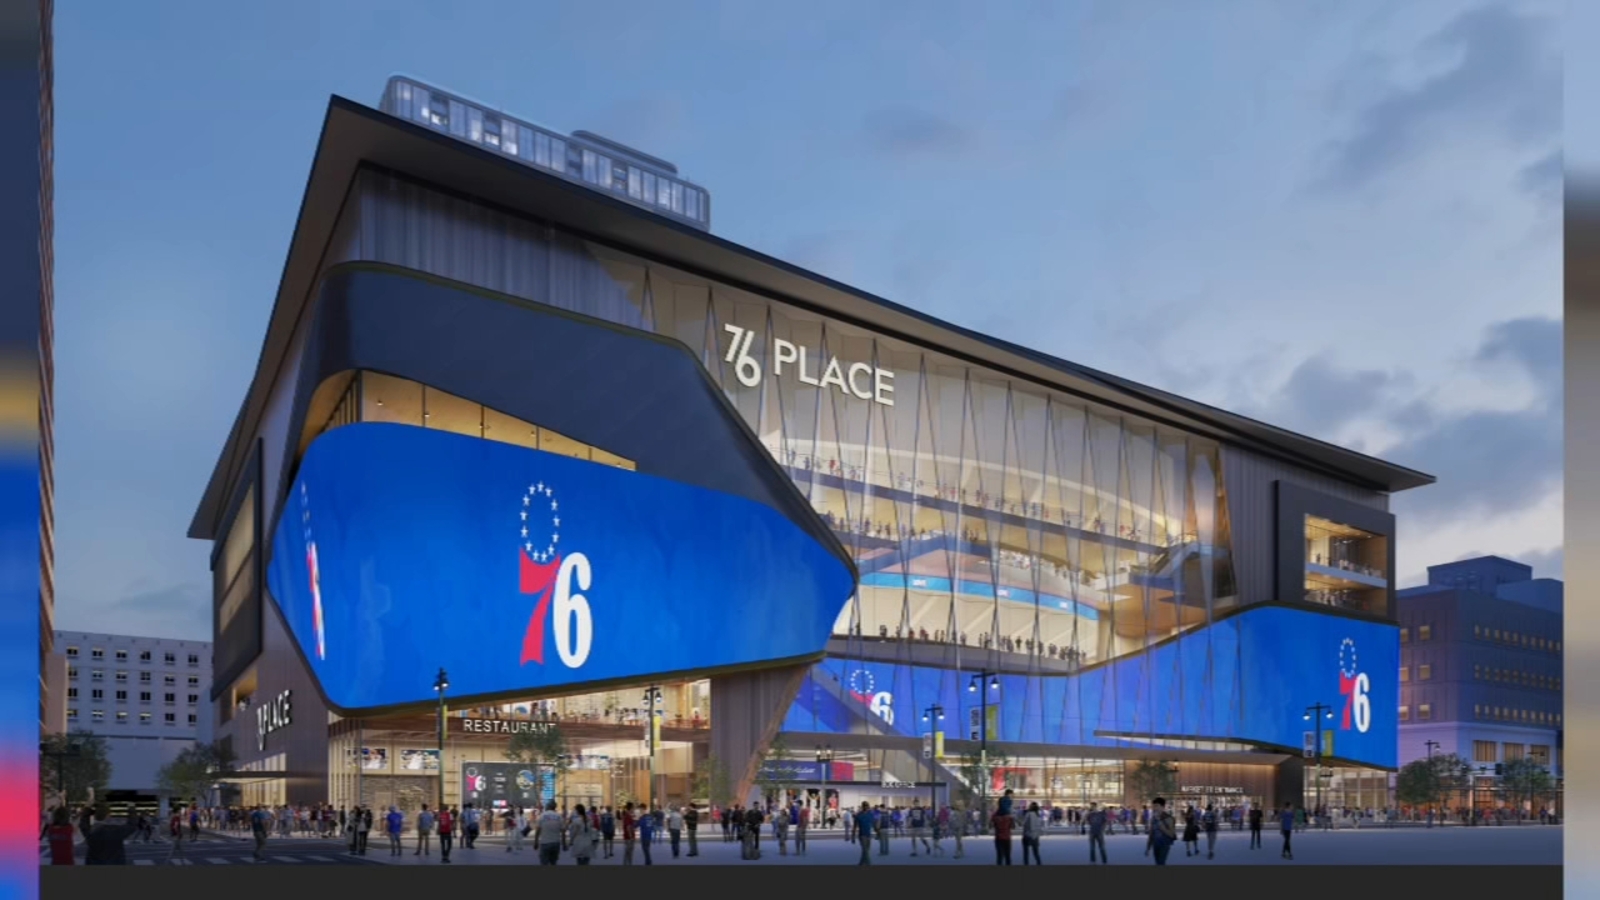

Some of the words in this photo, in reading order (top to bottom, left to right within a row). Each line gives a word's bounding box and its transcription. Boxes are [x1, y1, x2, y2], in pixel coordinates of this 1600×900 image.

[724, 323, 762, 387] 76
[773, 338, 895, 406] PLACE
[519, 546, 593, 669] 76
[1339, 670, 1371, 733] 76
